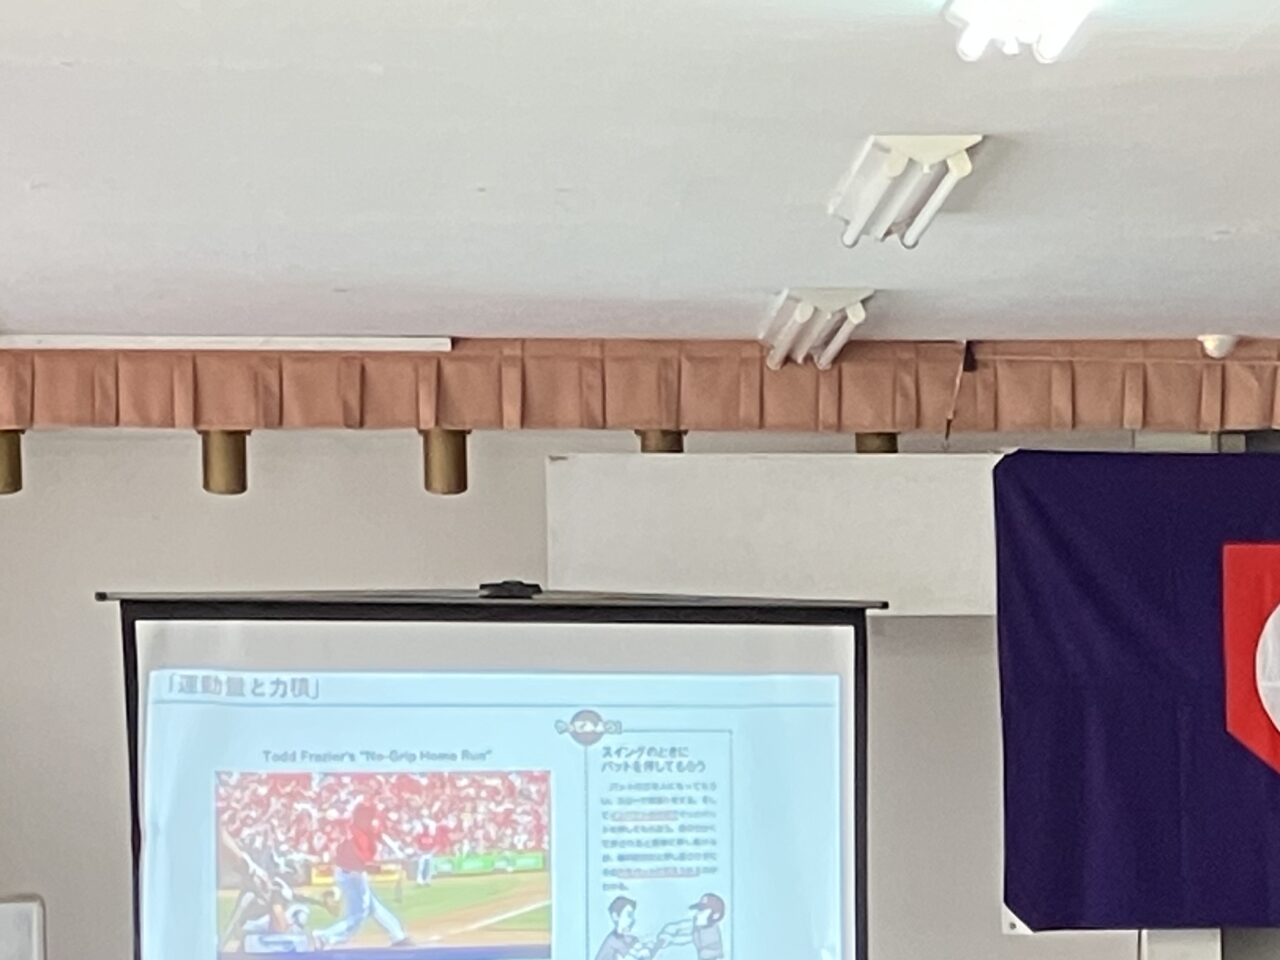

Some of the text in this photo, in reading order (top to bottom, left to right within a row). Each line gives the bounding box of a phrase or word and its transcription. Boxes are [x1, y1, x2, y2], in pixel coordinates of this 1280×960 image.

[262, 750, 297, 762] Todd
[302, 750, 356, 762] Frazier's
[419, 751, 458, 762] Home
